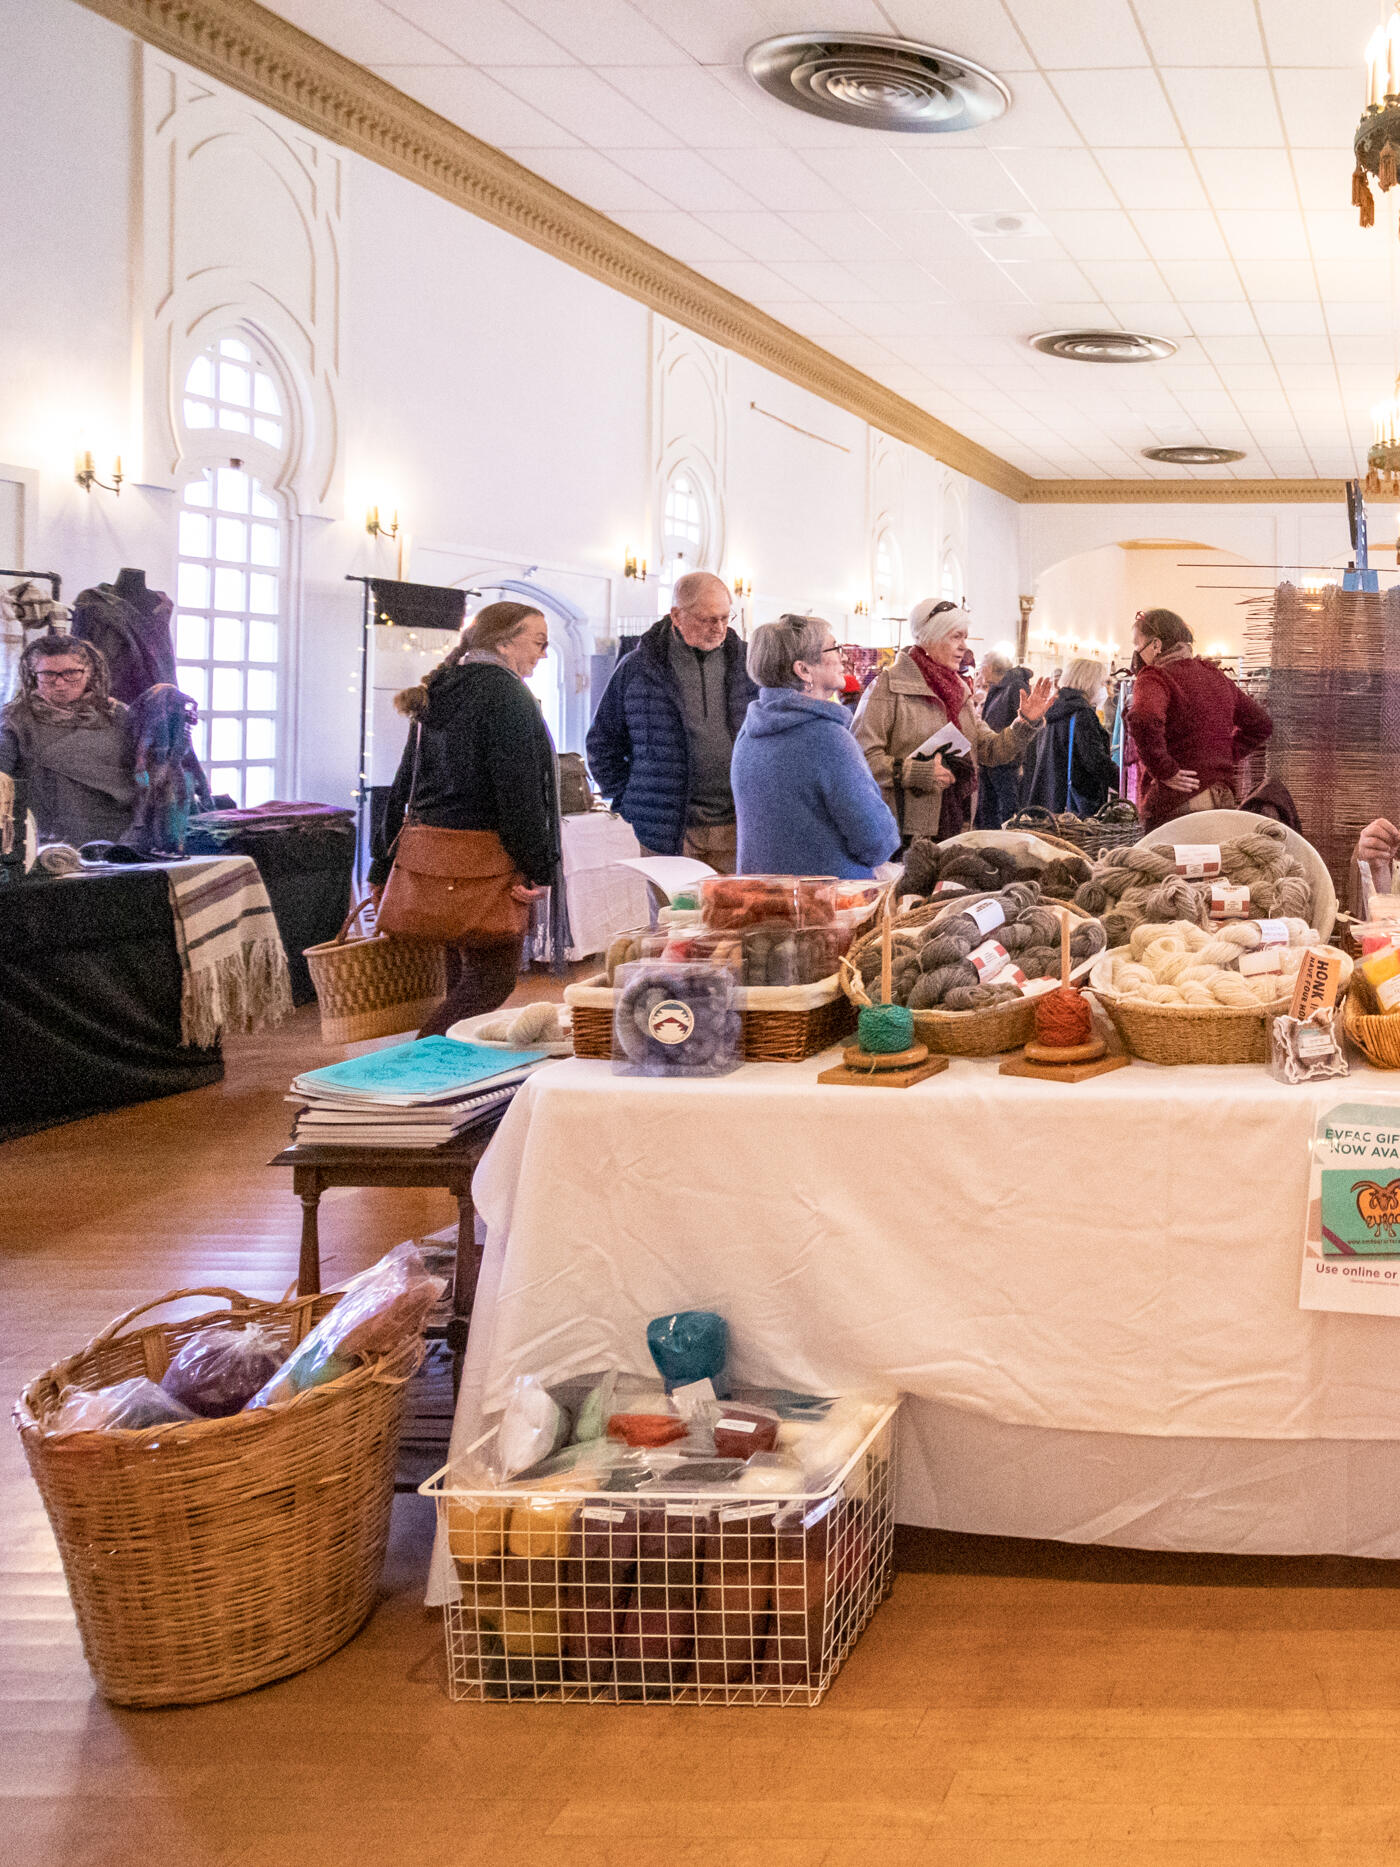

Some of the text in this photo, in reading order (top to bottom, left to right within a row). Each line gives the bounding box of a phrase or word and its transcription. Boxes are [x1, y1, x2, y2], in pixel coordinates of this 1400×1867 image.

[1306, 956, 1315, 979] HAVE
[1311, 959, 1329, 1001] HONK
[1301, 980, 1311, 1003] FOUR
[1325, 1128, 1372, 1143] EVFAC
[1330, 1142, 1367, 1156] NOW
[1316, 1263, 1338, 1275] Use
[1342, 1266, 1380, 1279] online
[1384, 1270, 1397, 1280] or
